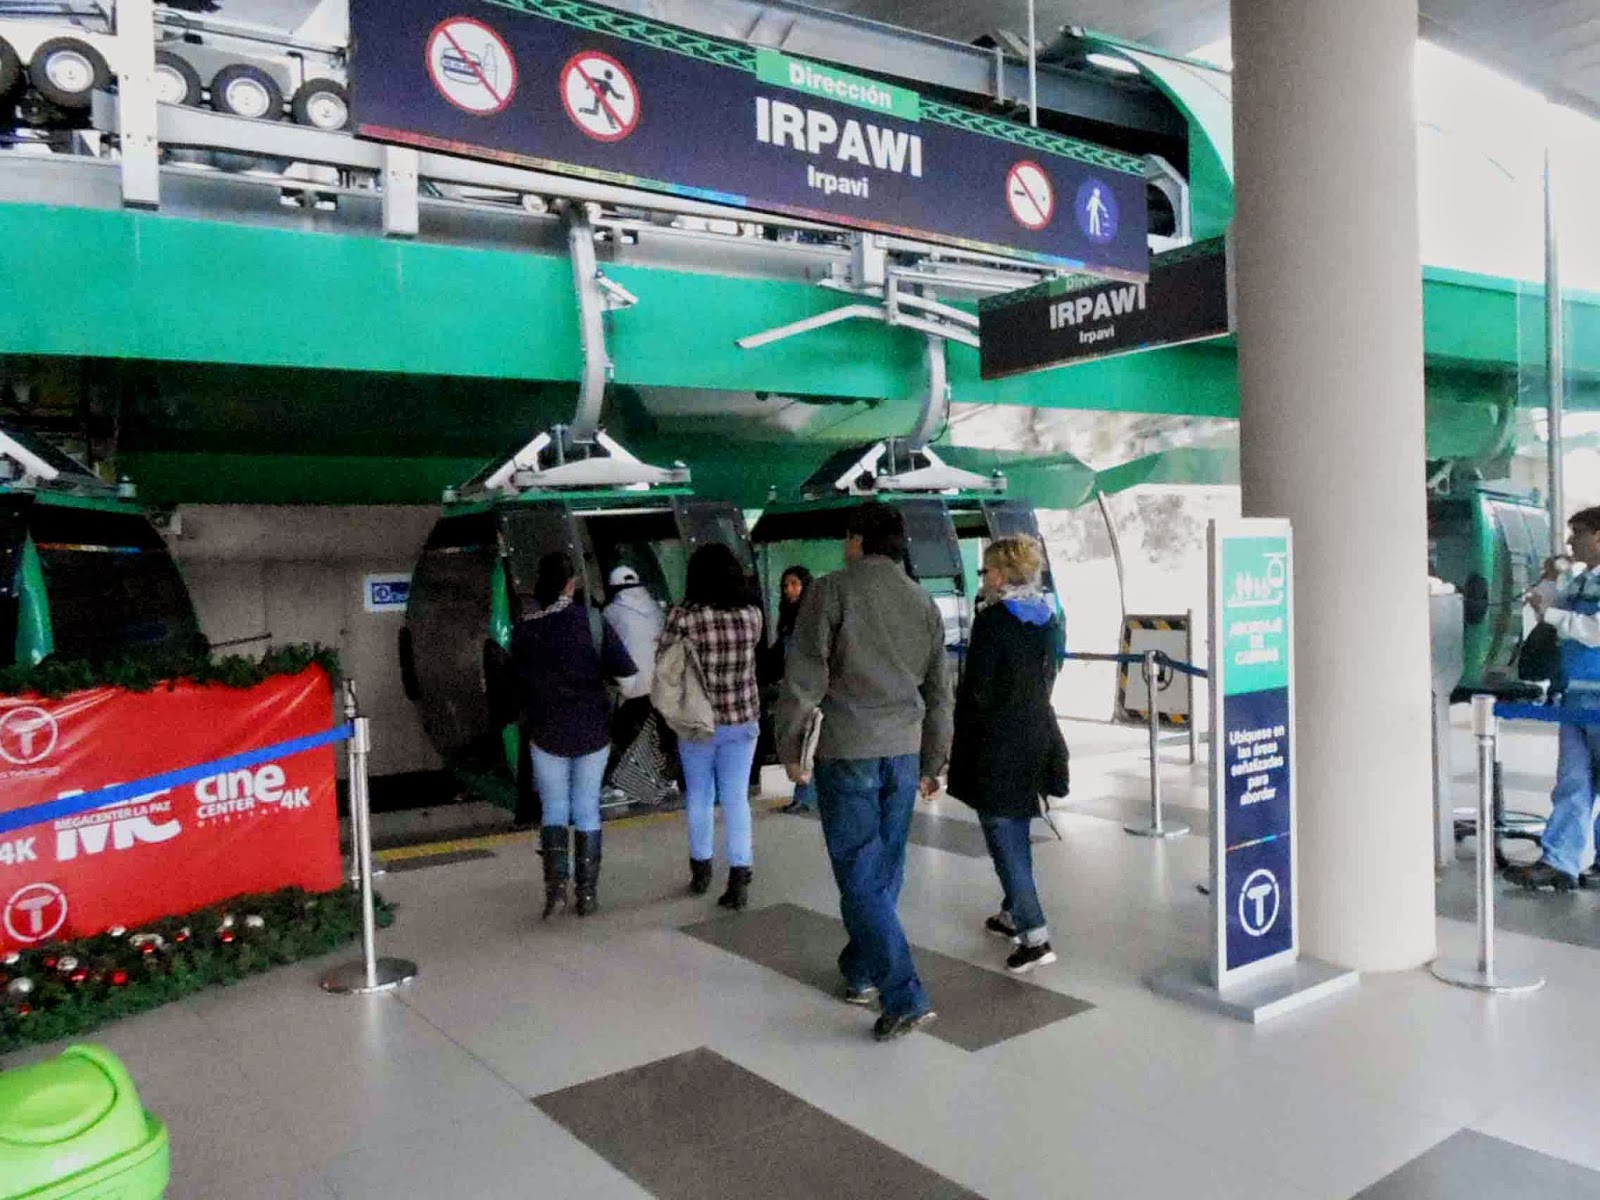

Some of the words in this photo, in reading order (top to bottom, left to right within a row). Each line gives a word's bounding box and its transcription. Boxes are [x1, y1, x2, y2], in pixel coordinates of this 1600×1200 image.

[789, 62, 892, 109] Dirección
[755, 96, 923, 178] IRPAWI
[806, 164, 869, 198] Irpavi
[1049, 282, 1147, 330] IRPAWI
[1079, 324, 1115, 345] Irpavi
[194, 764, 286, 804] cine
[197, 797, 255, 819] CENTER
[281, 785, 310, 810] 4K
[0, 836, 37, 866] 4K
